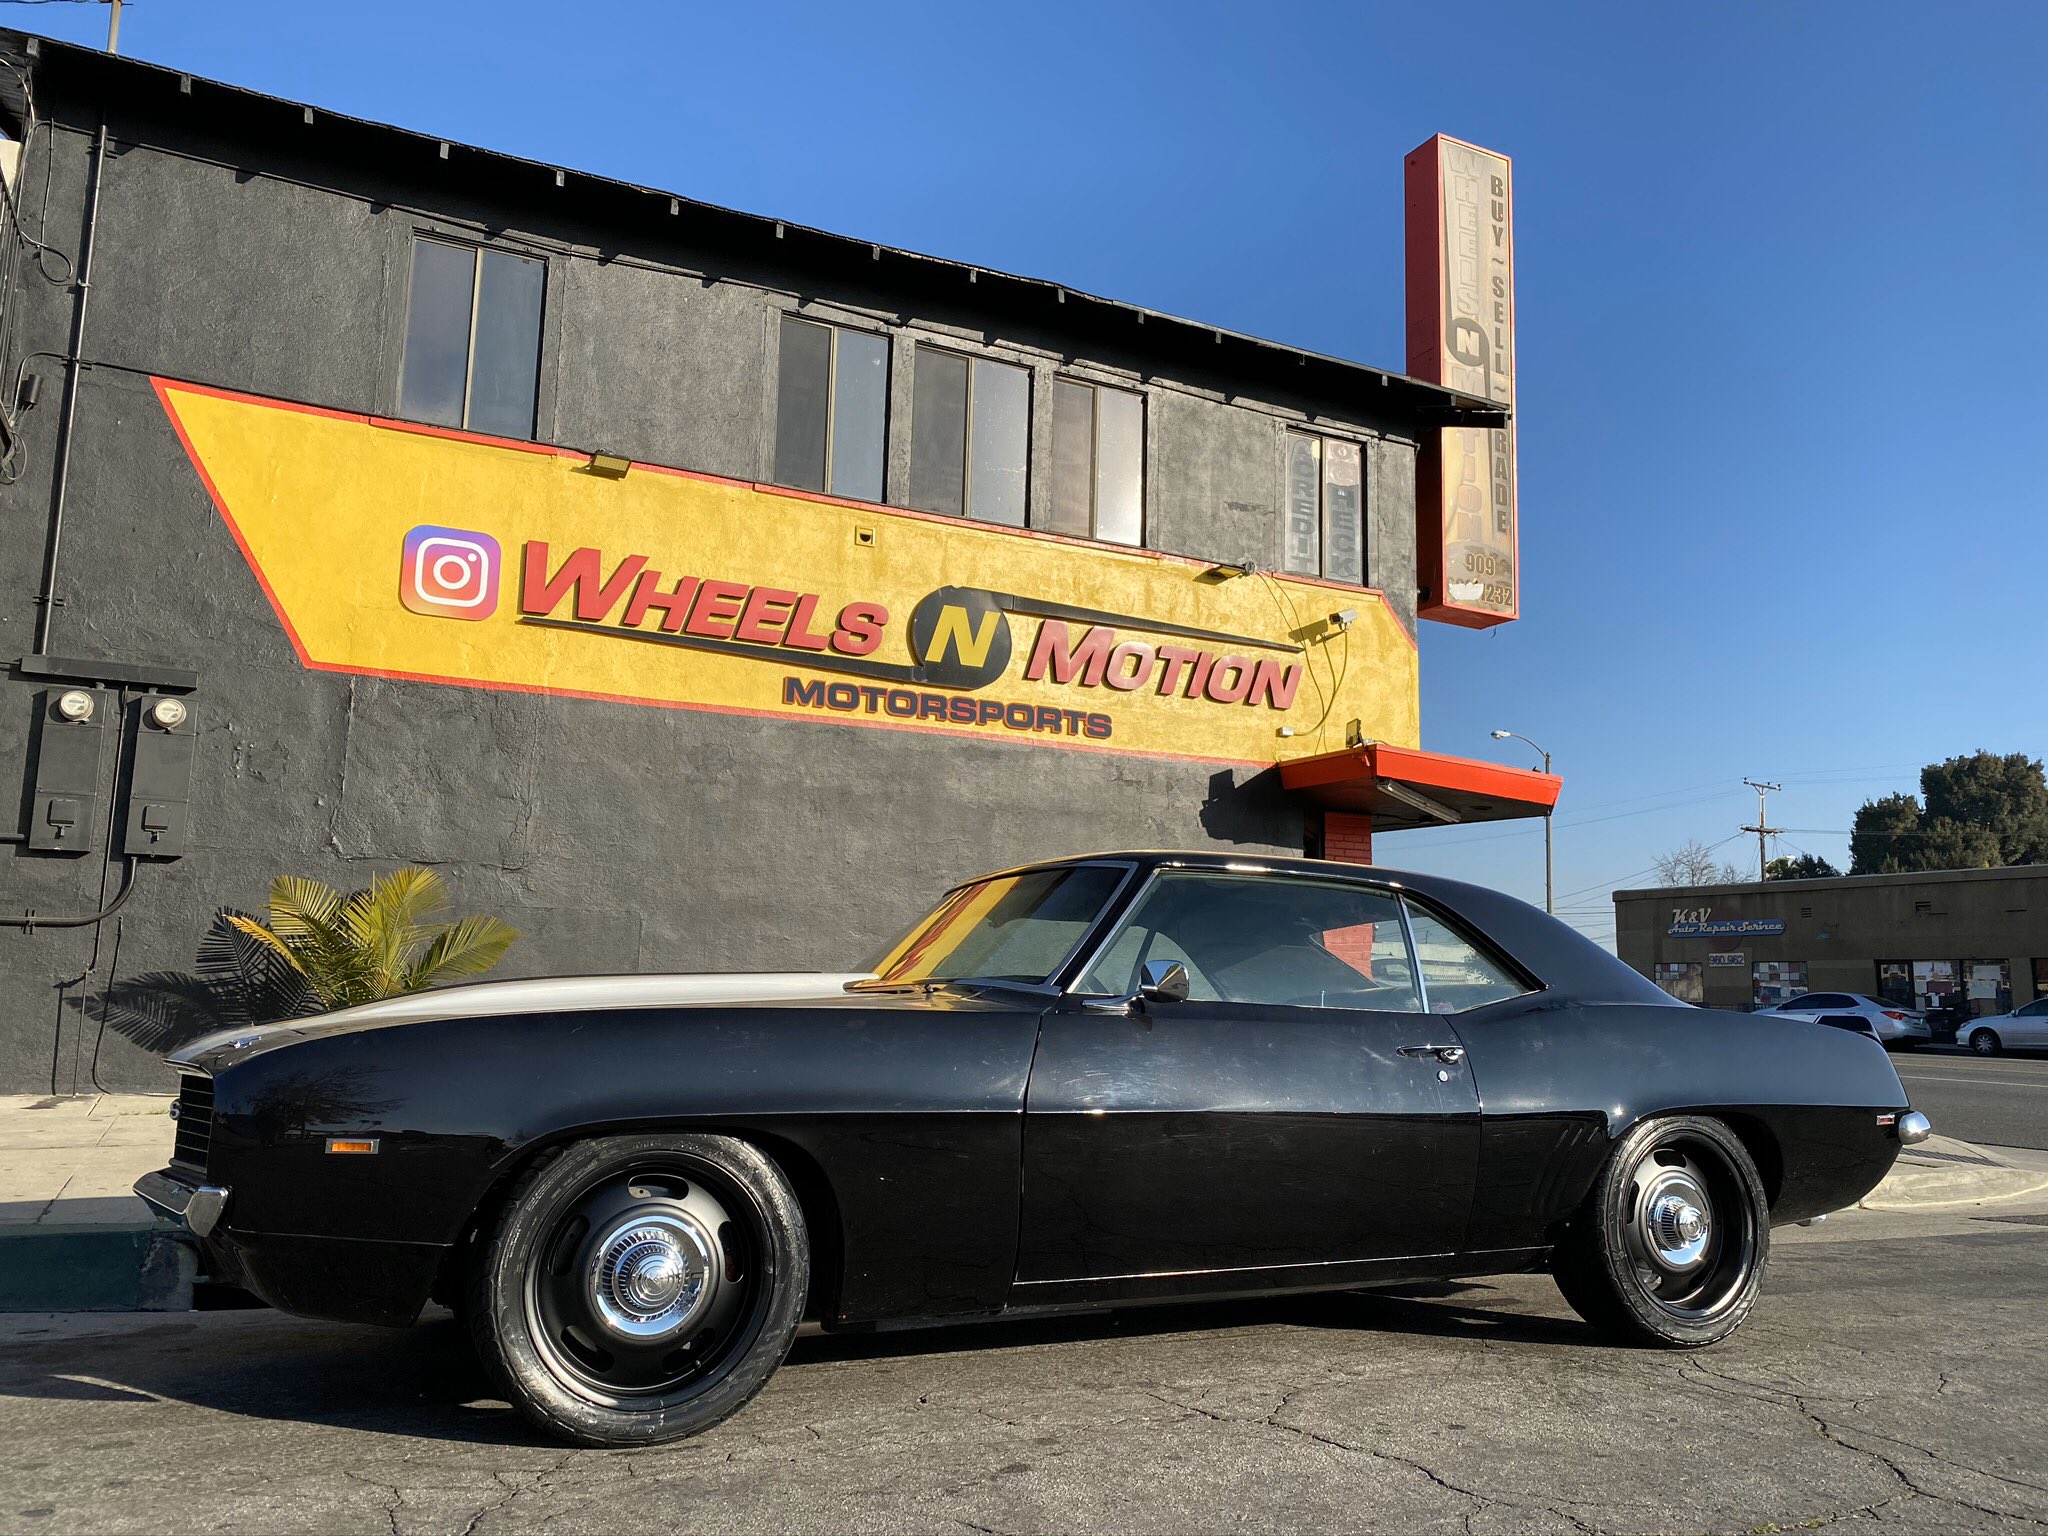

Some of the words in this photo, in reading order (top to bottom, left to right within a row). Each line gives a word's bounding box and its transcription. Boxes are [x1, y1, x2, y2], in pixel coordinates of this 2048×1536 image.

[1447, 147, 1485, 318] WHEELS
[1490, 175, 1504, 247] BUY
[1456, 326, 1480, 357] N
[1492, 275, 1505, 374] SELL
[1452, 366, 1483, 541] MTION
[1495, 431, 1508, 533] RADE
[1465, 553, 1496, 577] 909
[925, 605, 1001, 668] N
[1026, 619, 1303, 710] MOTION
[782, 677, 1112, 739] MOTORSPORTS
[1668, 924, 1698, 934] Auto
[1698, 922, 1737, 935] Repair
[1737, 920, 1784, 932] Service
